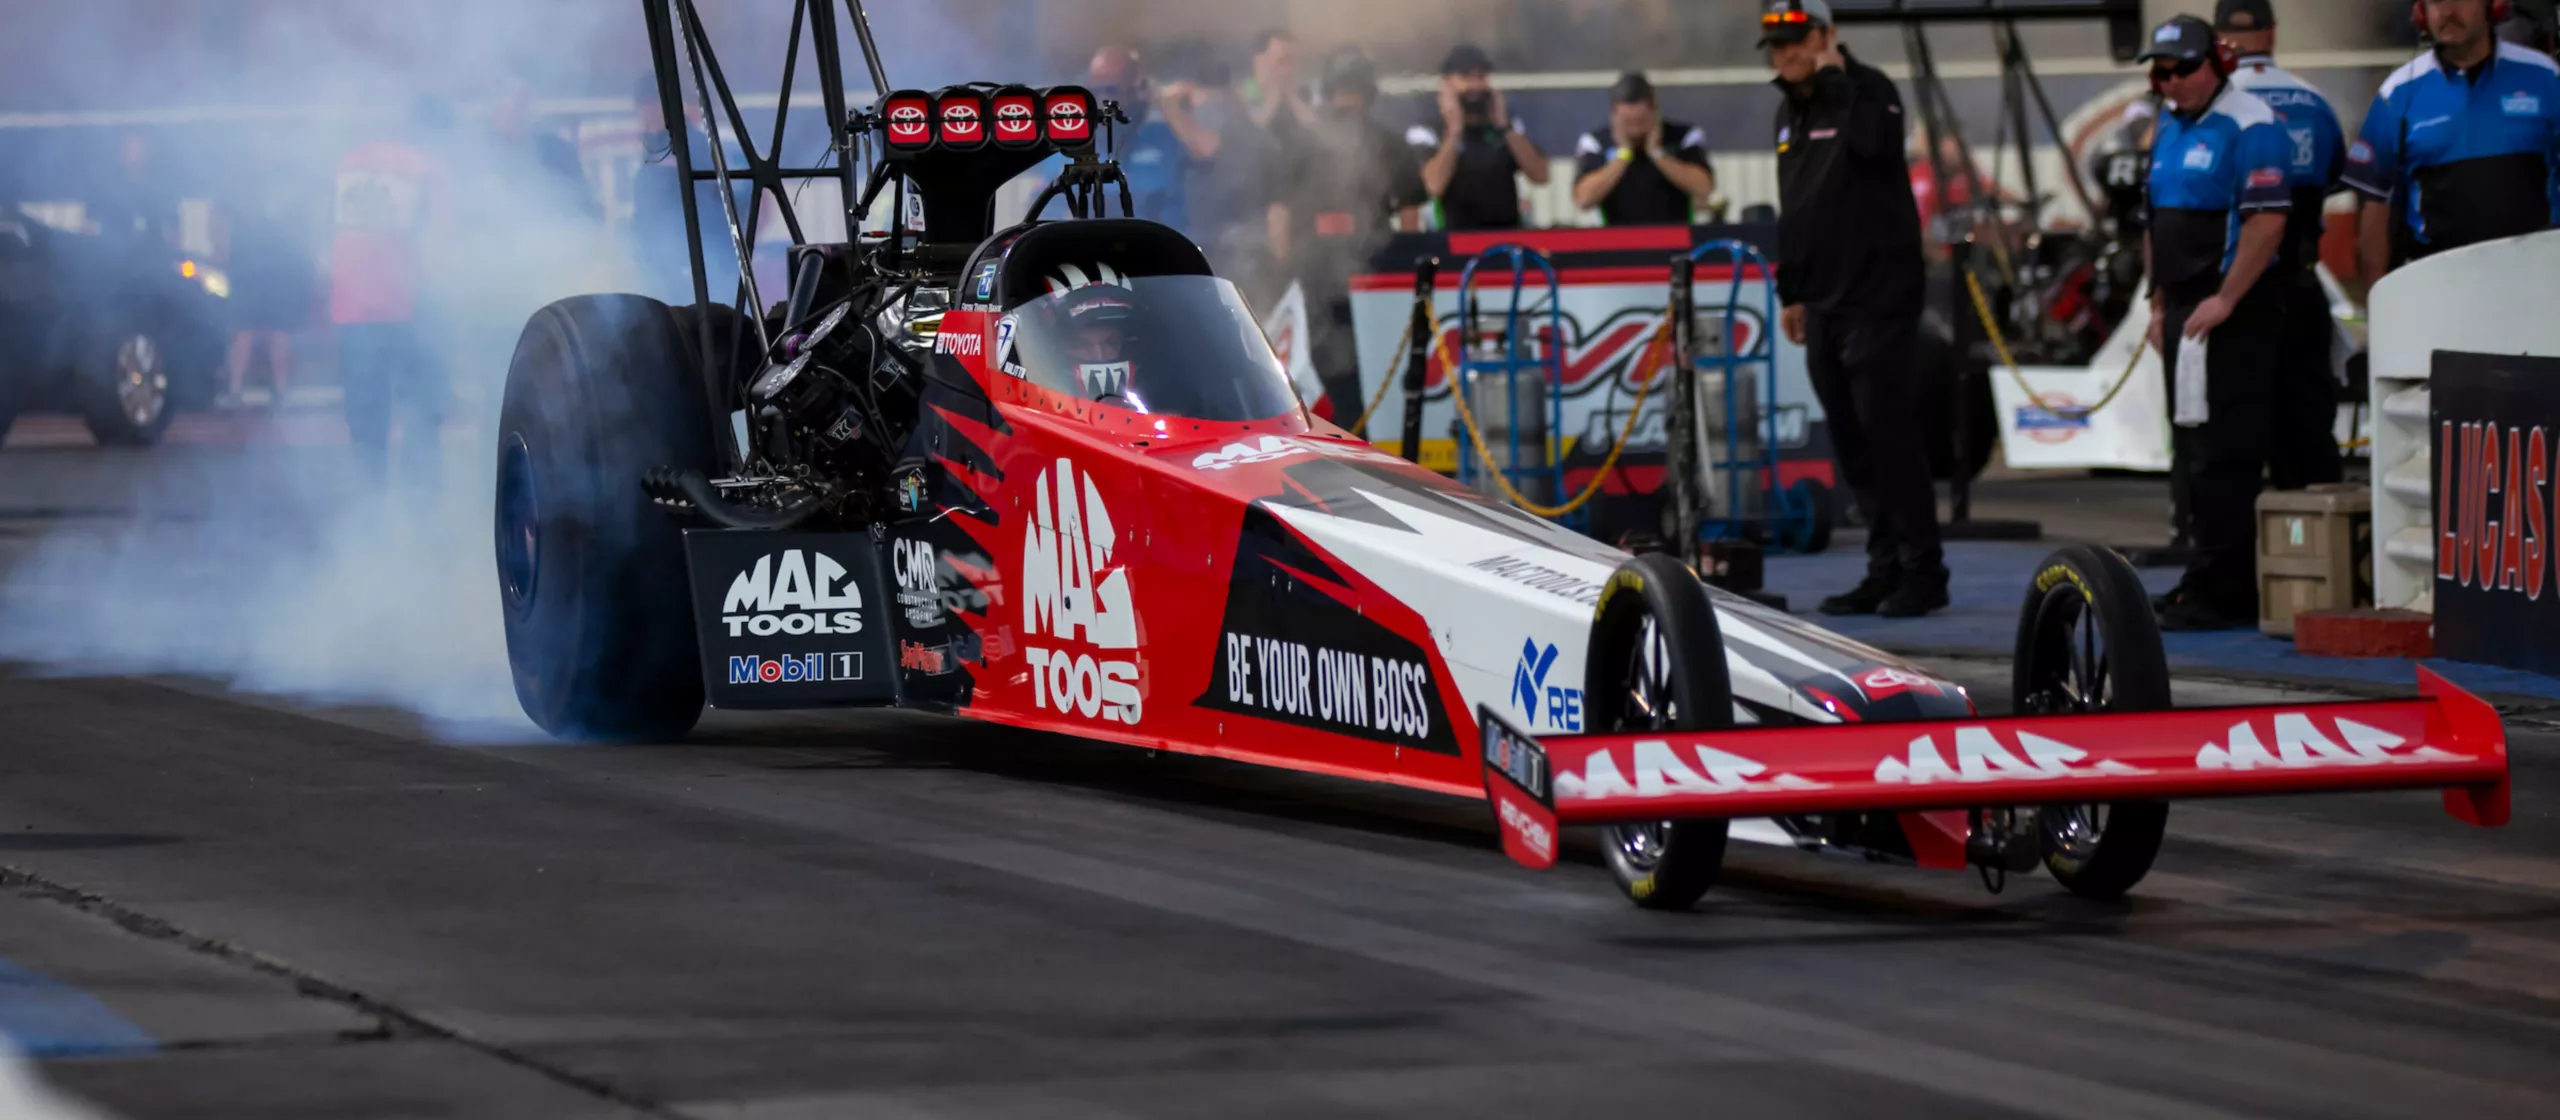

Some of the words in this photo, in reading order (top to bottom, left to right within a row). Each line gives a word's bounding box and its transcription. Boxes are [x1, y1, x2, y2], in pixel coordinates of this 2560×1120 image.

[943, 333, 981, 355] TOYOTA
[2437, 420, 2547, 601] LUCAS
[722, 549, 862, 613] MAC
[1023, 457, 1138, 649] MAC
[722, 611, 863, 637] TOOLS
[896, 592, 938, 610] CONSTRUCTION
[729, 652, 824, 684] Mobil
[1025, 646, 1143, 725] TOOS
[1227, 632, 1254, 706] BE
[1256, 636, 1314, 717] YOUR
[1317, 646, 1369, 728] OWN
[1372, 656, 1429, 740] BOSS
[1874, 725, 2159, 783] MAC
[2196, 712, 2480, 771] MAC
